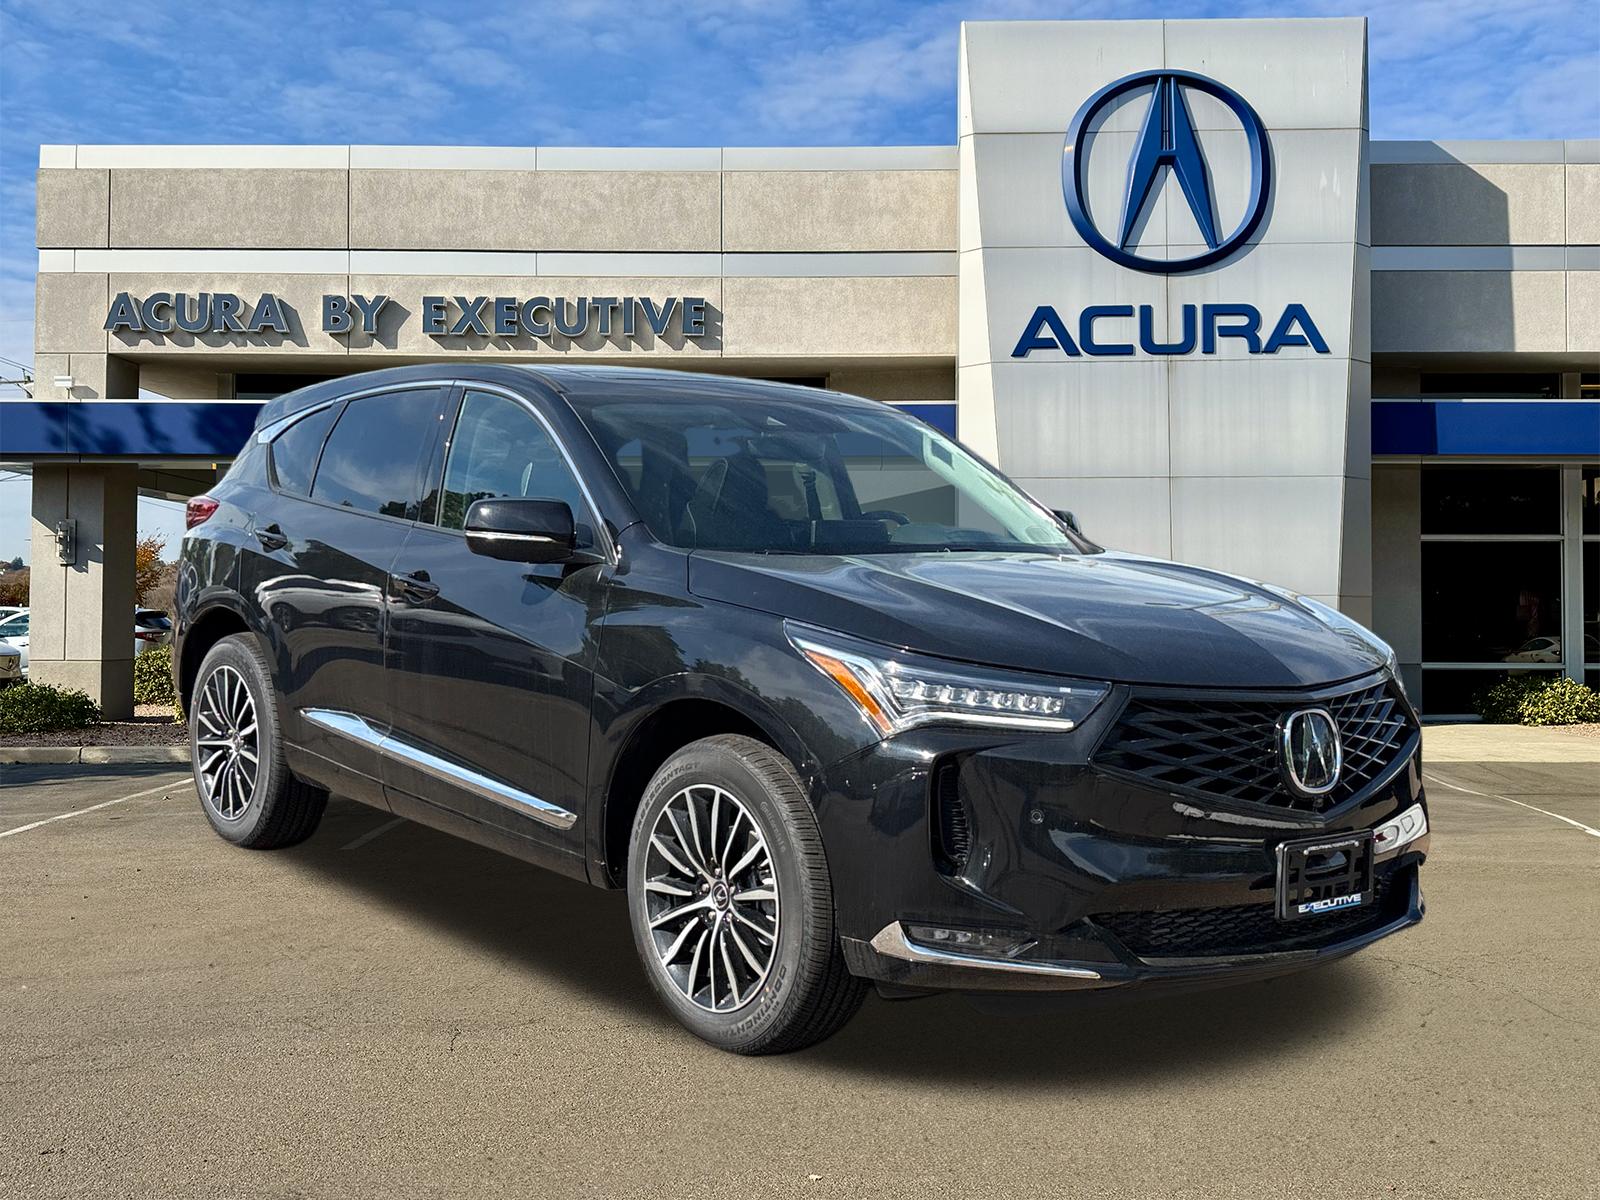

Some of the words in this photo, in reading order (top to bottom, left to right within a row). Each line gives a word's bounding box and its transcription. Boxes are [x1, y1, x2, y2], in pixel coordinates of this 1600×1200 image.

[103, 292, 290, 333] ACURA
[322, 294, 391, 334] BY
[422, 296, 707, 337] EXECUTIVE
[1010, 303, 1332, 357] ACURA
[1298, 893, 1362, 913] EXECUTIVE
